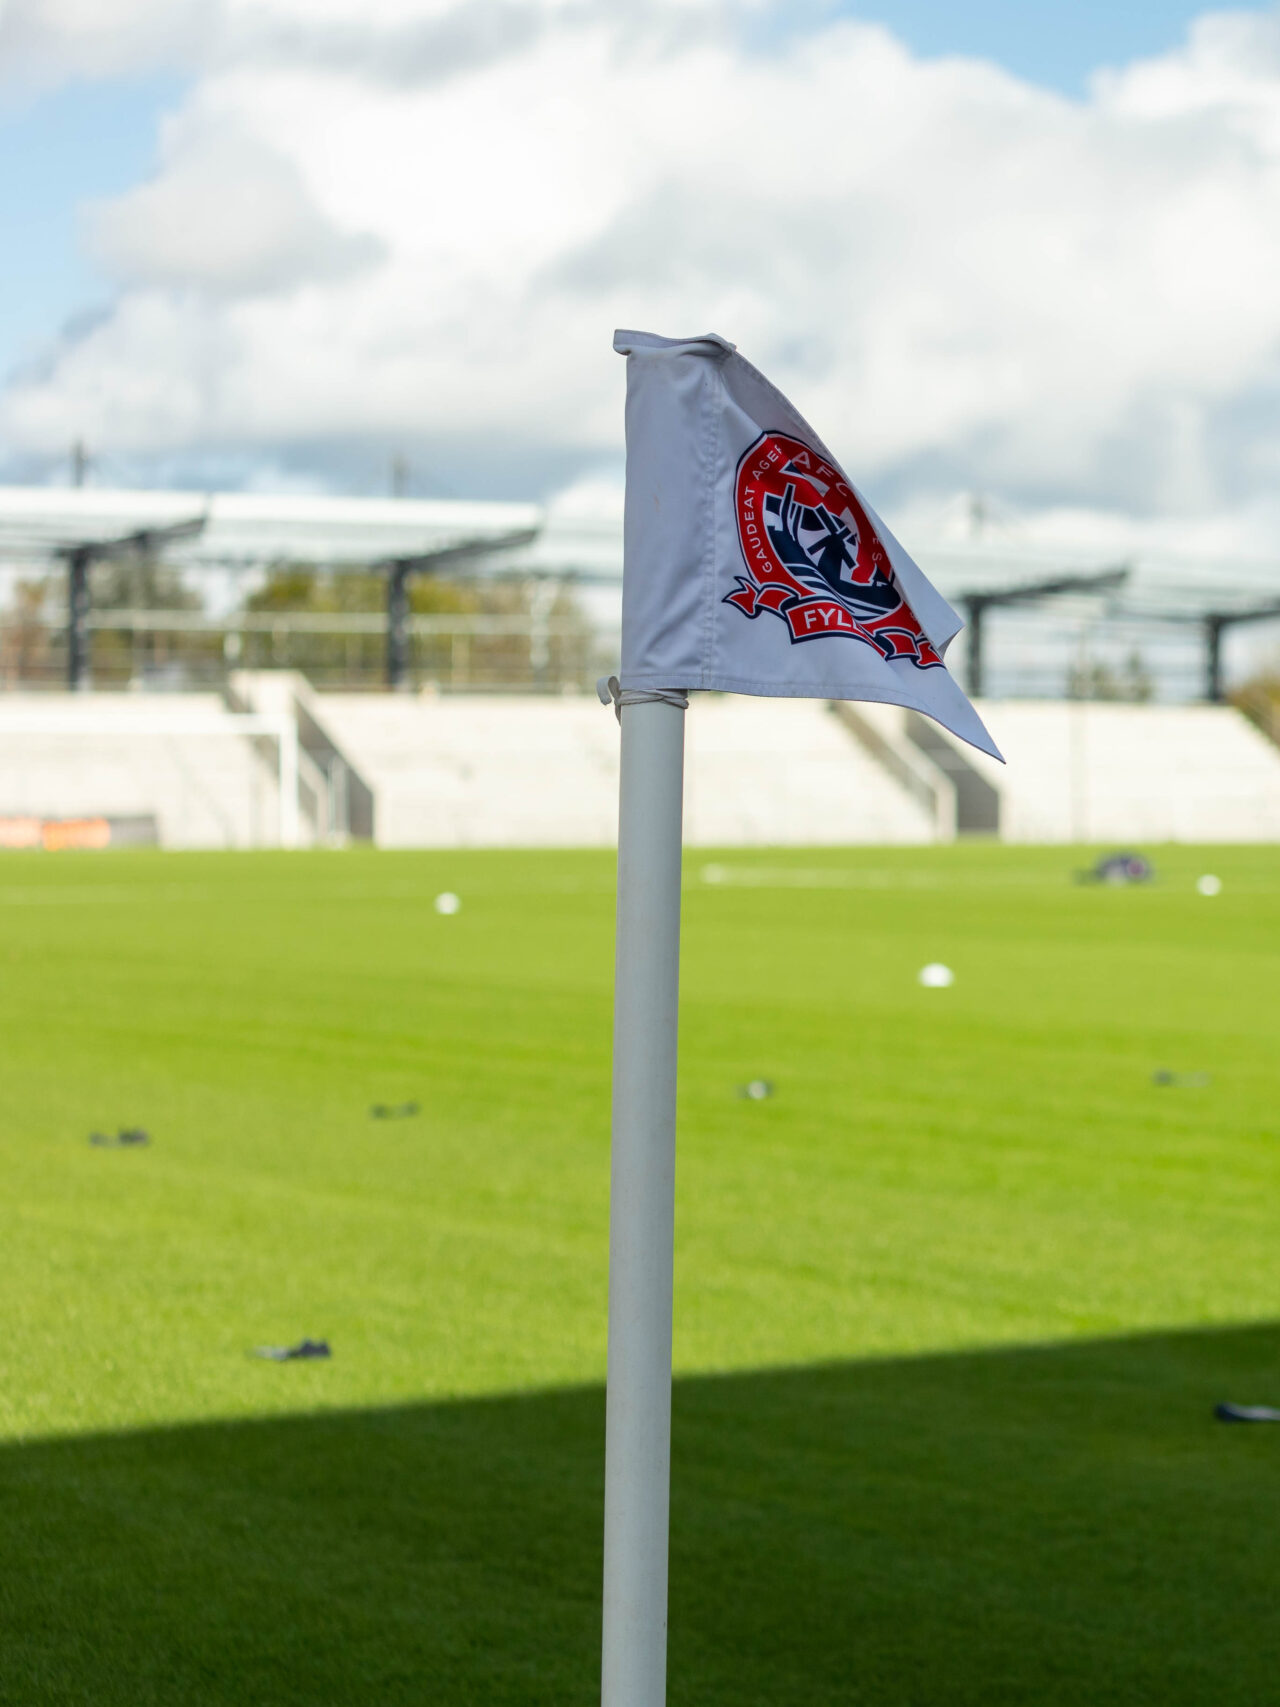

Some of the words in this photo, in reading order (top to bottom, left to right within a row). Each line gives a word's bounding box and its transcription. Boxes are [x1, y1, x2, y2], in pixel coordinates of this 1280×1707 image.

[791, 450, 849, 497] AFC
[744, 486, 773, 573] GAUDEAT
[803, 608, 857, 630] FYL
